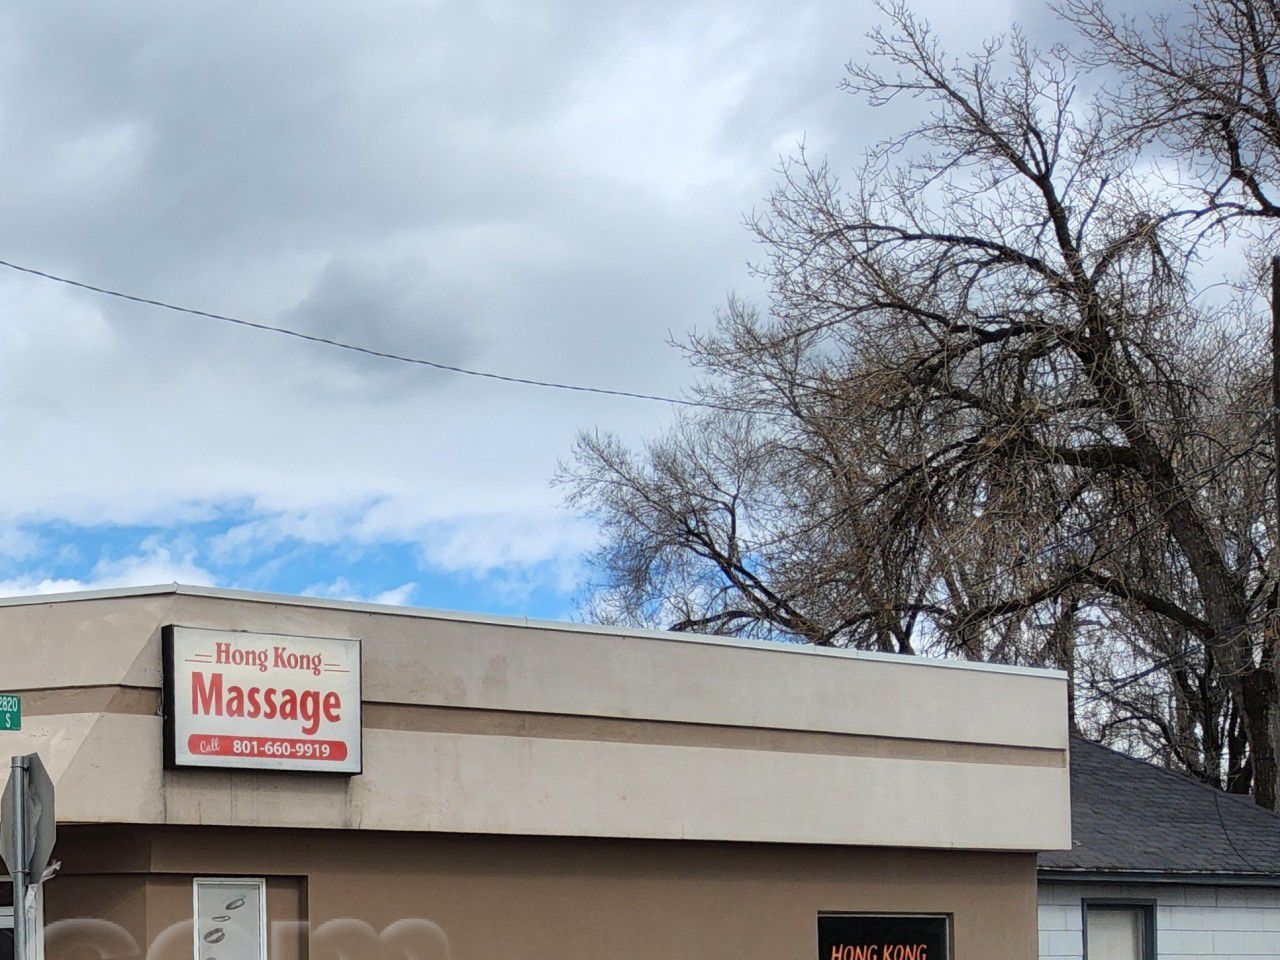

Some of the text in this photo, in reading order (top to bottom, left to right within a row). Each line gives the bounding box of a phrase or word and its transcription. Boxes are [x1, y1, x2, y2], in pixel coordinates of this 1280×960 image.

[215, 642, 322, 676] Hong Kong
[191, 671, 342, 735] Massage
[5, 713, 11, 728] S
[199, 739, 330, 757] Call 801-660-9919
